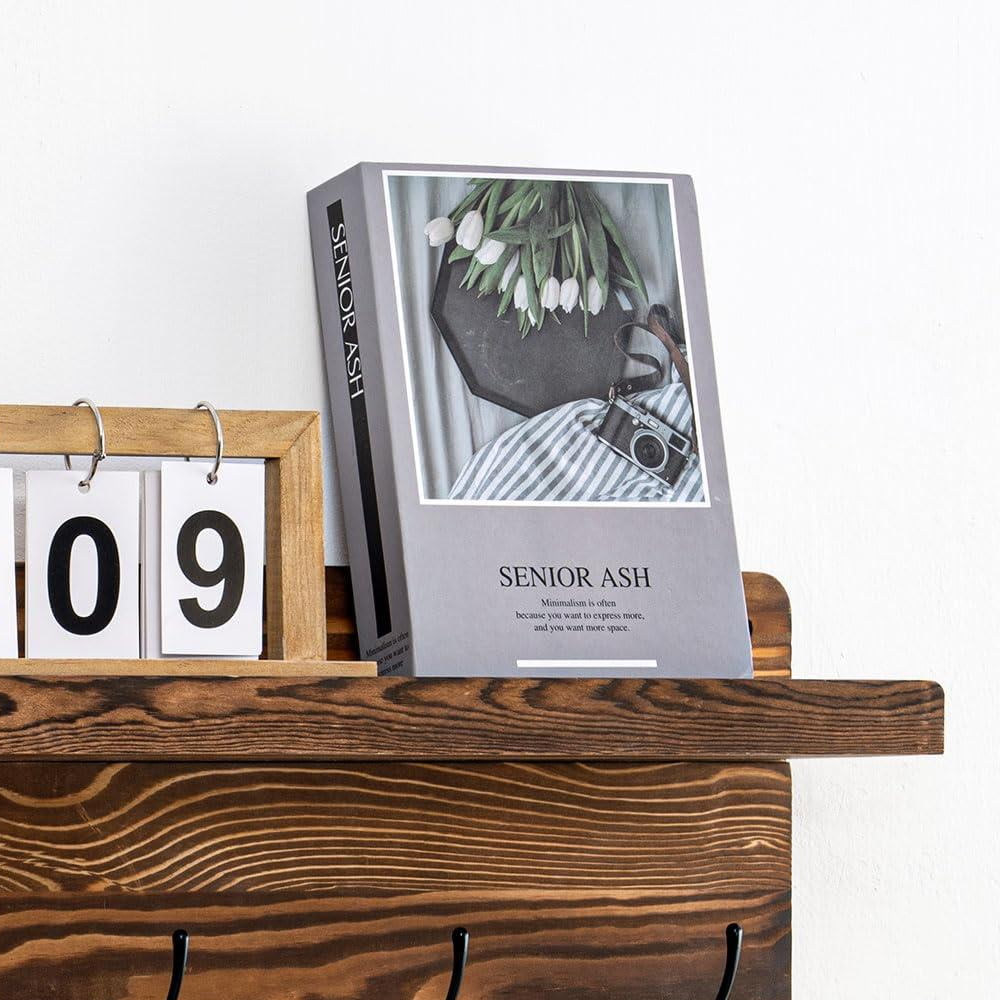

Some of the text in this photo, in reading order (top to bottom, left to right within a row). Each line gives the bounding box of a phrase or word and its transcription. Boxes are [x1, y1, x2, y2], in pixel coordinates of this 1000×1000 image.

[331, 223, 364, 399] SENIOR ASH
[47, 509, 245, 635] 0 9
[499, 566, 651, 588] SENIOR ASH
[541, 598, 617, 607] Minimalism is often
[515, 610, 546, 619] because
[547, 613, 562, 621] you
[592, 613, 621, 621] express
[534, 623, 548, 631] and
[549, 625, 564, 633] you
